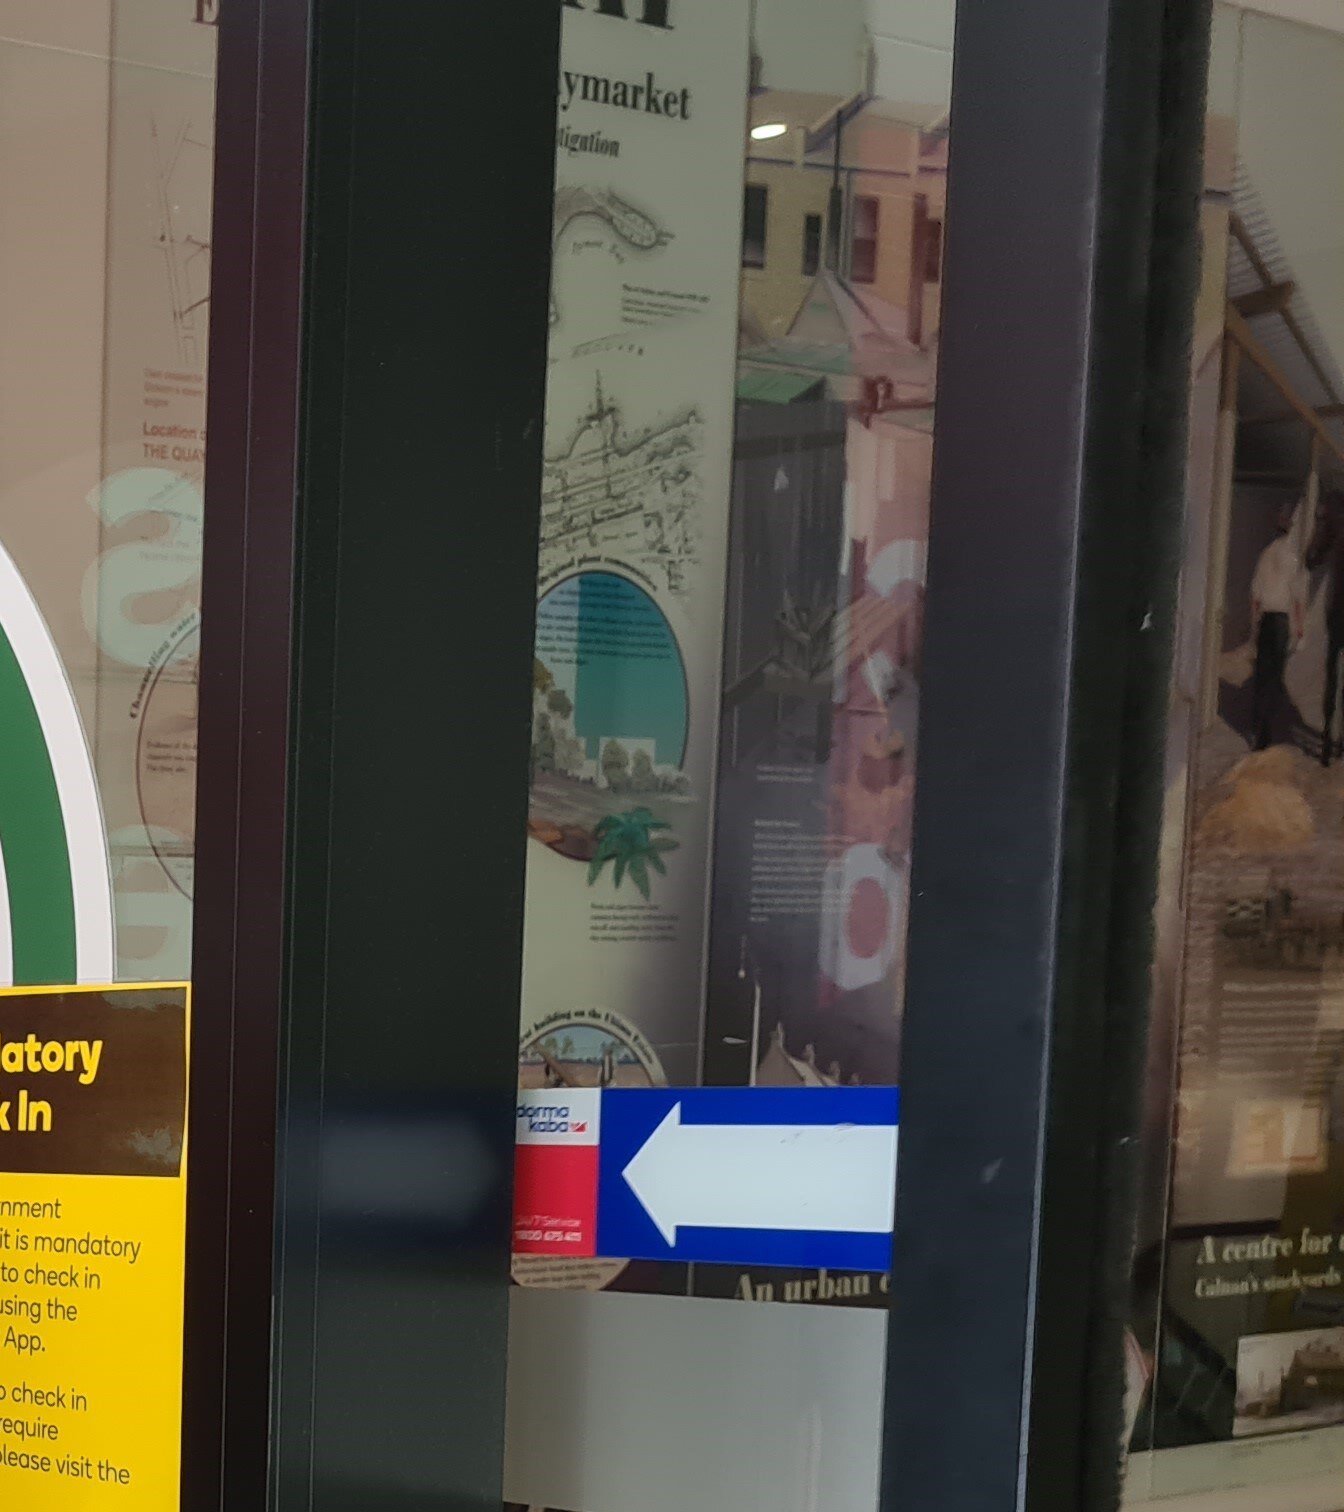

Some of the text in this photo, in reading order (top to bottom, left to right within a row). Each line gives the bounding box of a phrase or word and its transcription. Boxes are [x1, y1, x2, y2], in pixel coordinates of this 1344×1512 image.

[18, 1089, 52, 1132] In
[0, 1228, 10, 1250] it
[15, 1228, 29, 1251] is
[34, 1232, 141, 1265] mandatory
[1, 1264, 19, 1283] to
[24, 1262, 79, 1288] check
[84, 1266, 101, 1290] in
[784, 1267, 870, 1302] urban
[47, 1298, 78, 1322] the
[3, 1326, 46, 1356] App.
[12, 1381, 66, 1409] check
[71, 1388, 87, 1412] in
[55, 1453, 93, 1479] visit
[98, 1458, 131, 1485] the
